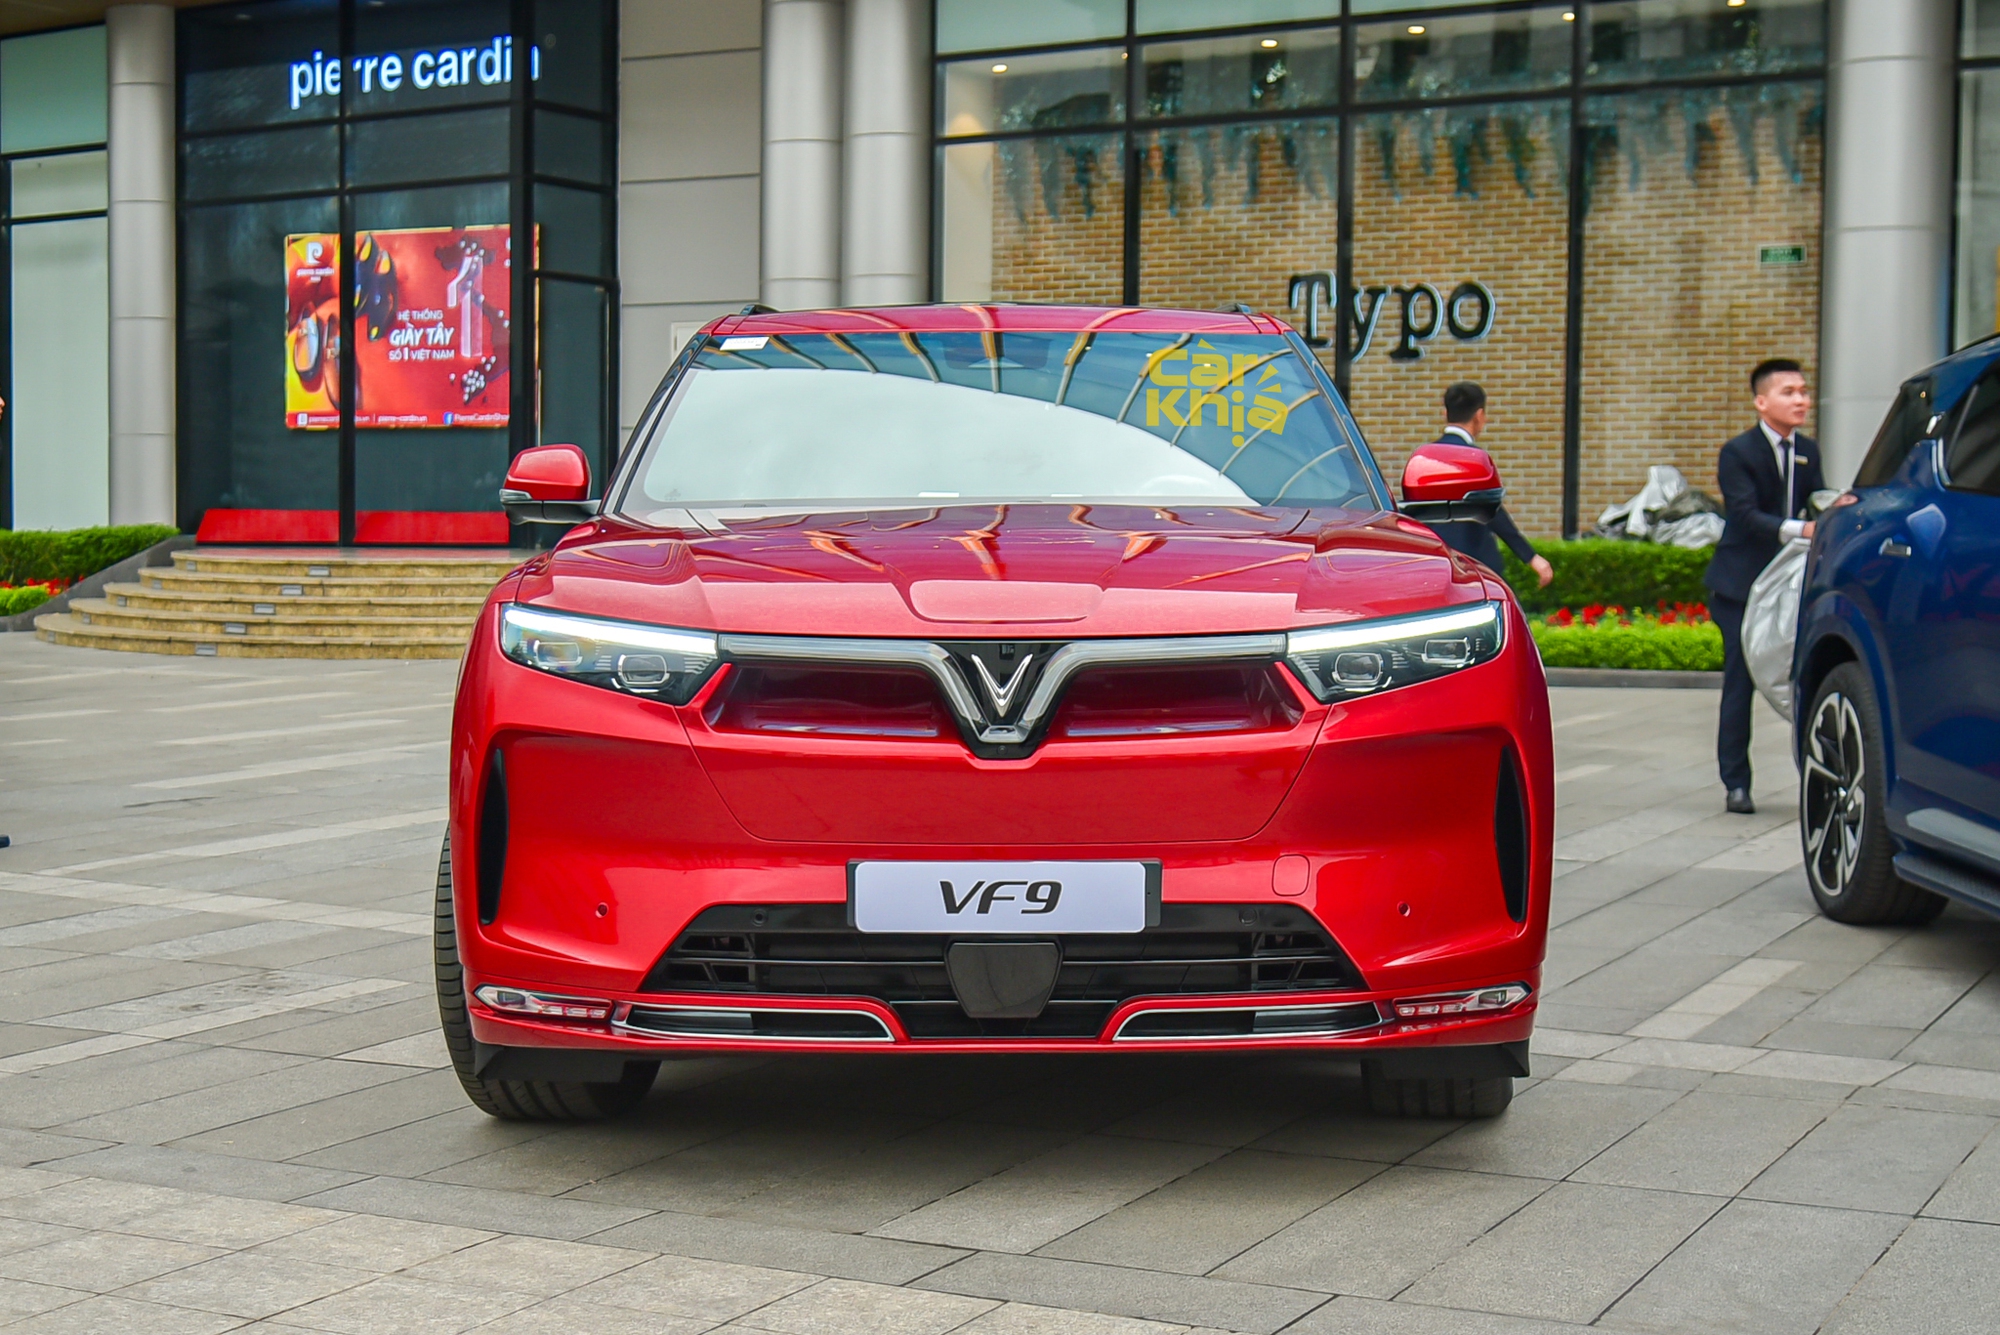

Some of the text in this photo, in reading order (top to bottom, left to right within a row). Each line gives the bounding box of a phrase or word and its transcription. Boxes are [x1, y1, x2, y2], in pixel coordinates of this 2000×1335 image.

[411, 35, 540, 88] cardi
[389, 321, 455, 346] GIÀY TÂY
[1289, 270, 1496, 364] Typo
[432, 349, 455, 360] NAM
[939, 880, 1063, 915] VF9
